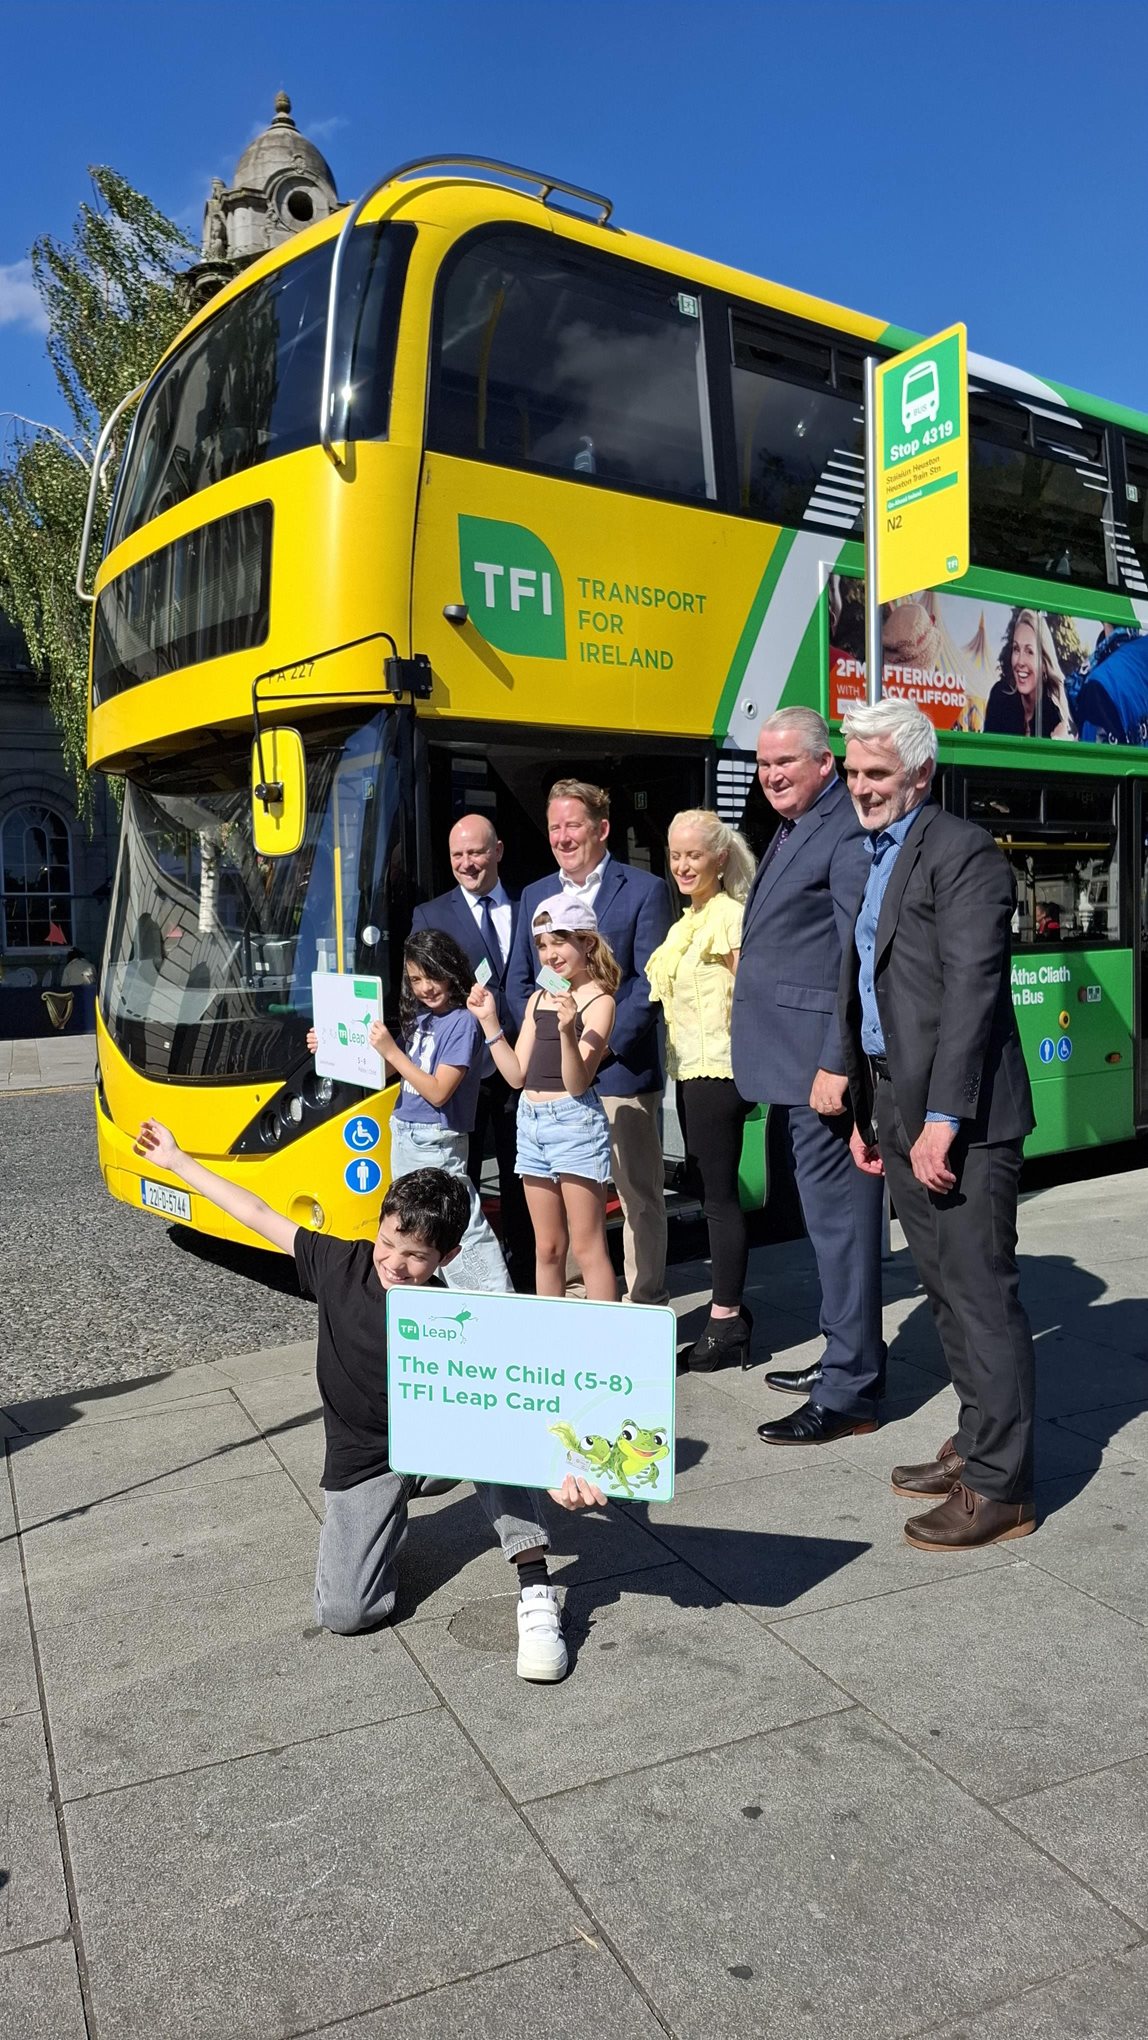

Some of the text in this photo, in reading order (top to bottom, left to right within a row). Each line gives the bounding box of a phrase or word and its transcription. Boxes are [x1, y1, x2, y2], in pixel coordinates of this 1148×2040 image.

[890, 420, 953, 462] Stop 4319
[912, 456, 940, 473] Heuston
[885, 465, 942, 494] Heuston Train Stn
[887, 515, 902, 532] N2
[473, 561, 553, 616] TFI
[577, 577, 707, 614] TRANSPORT
[579, 609, 624, 634] FOR
[580, 641, 674, 671] IRELAND
[291, 665, 314, 679] 227
[836, 658, 967, 691] 2FM FTERNOON
[836, 683, 967, 707] WITH ACY CLIFFORD
[1010, 964, 1071, 985] Átha Cliath
[1022, 988, 1044, 1006] Bus
[349, 1029, 365, 1046] Leap
[400, 1324, 457, 1341] TFI Leap
[398, 1355, 634, 1396] The New Child (5-8)
[398, 1382, 561, 1414] TFI Leap Card
